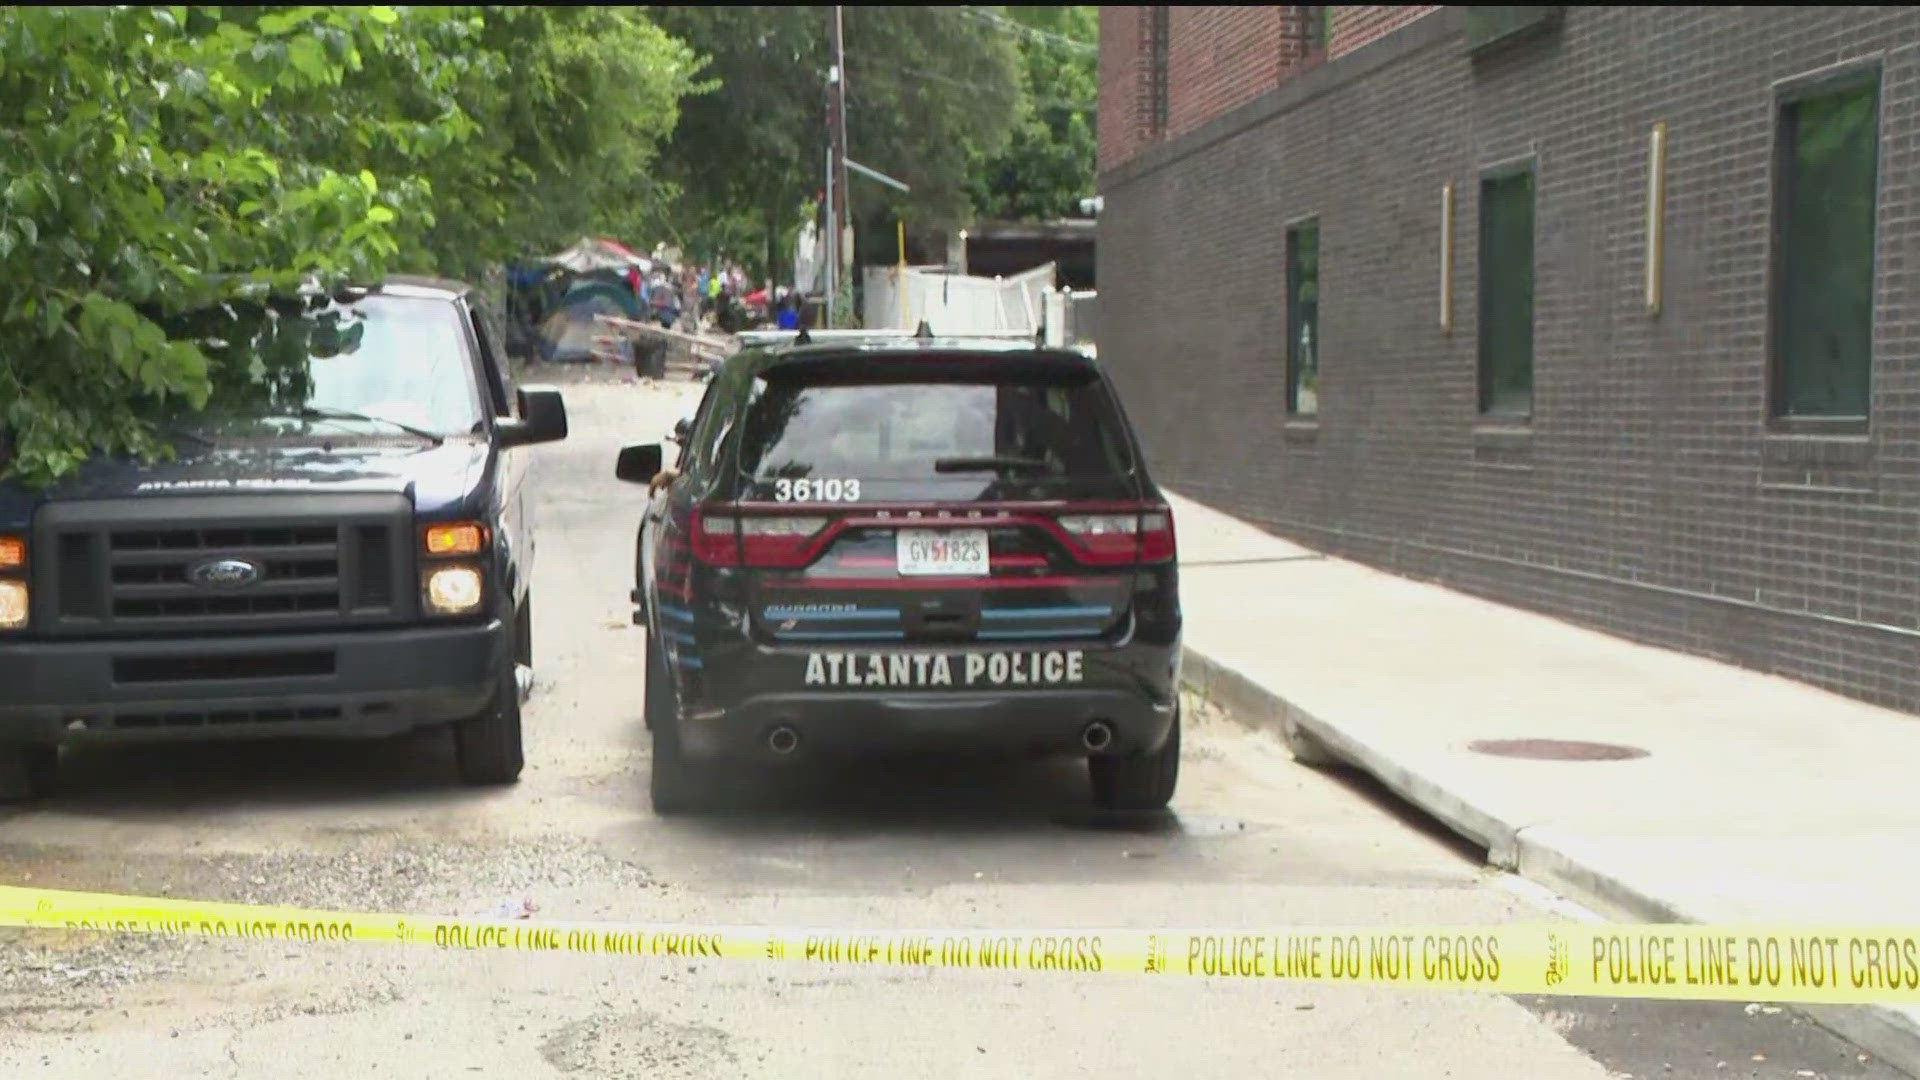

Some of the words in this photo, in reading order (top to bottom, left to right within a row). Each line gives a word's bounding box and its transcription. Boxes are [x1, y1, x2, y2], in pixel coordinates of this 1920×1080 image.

[775, 479, 861, 502] 36103
[804, 652, 953, 686] ATLANTA
[965, 650, 1084, 683] POLICE
[805, 935, 879, 964] POLICE
[941, 935, 971, 968] DO
[979, 936, 1022, 969] NOT
[1029, 936, 1103, 973] CROSS
[1188, 935, 1266, 977] POLICE
[1274, 935, 1322, 979] LINE
[1331, 935, 1361, 979] DO
[1370, 935, 1414, 981] NOT
[1423, 935, 1500, 982] CROSS
[1593, 935, 1677, 984] POLICE
[1685, 936, 1739, 986] LINE
[1747, 937, 1781, 987] DO
[1790, 937, 1839, 989] NOT
